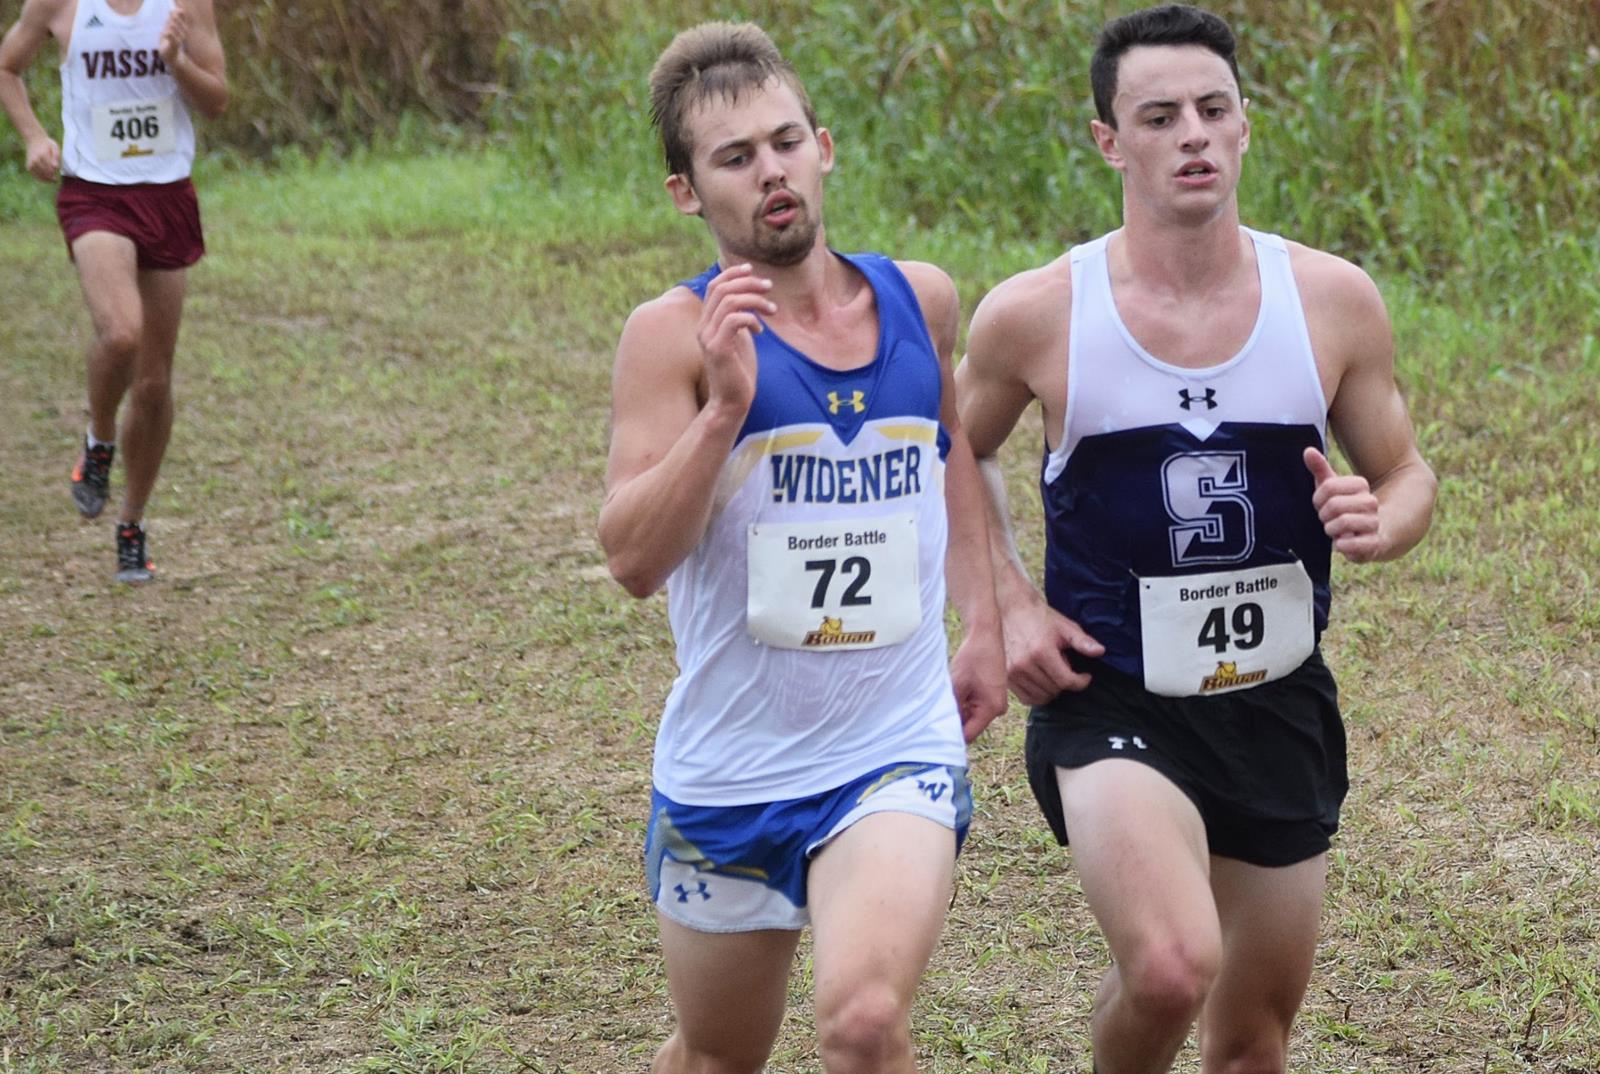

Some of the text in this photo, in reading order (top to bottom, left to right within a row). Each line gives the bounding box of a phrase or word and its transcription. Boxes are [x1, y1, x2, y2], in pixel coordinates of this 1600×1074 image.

[81, 50, 166, 79] VASSA
[111, 116, 159, 141] 406
[770, 445, 921, 504] WIDENER
[1160, 450, 1255, 567] S
[788, 530, 887, 551] Border Battle
[804, 556, 872, 609] 72
[1180, 577, 1278, 602] Border Battle
[1197, 602, 1265, 654] 49
